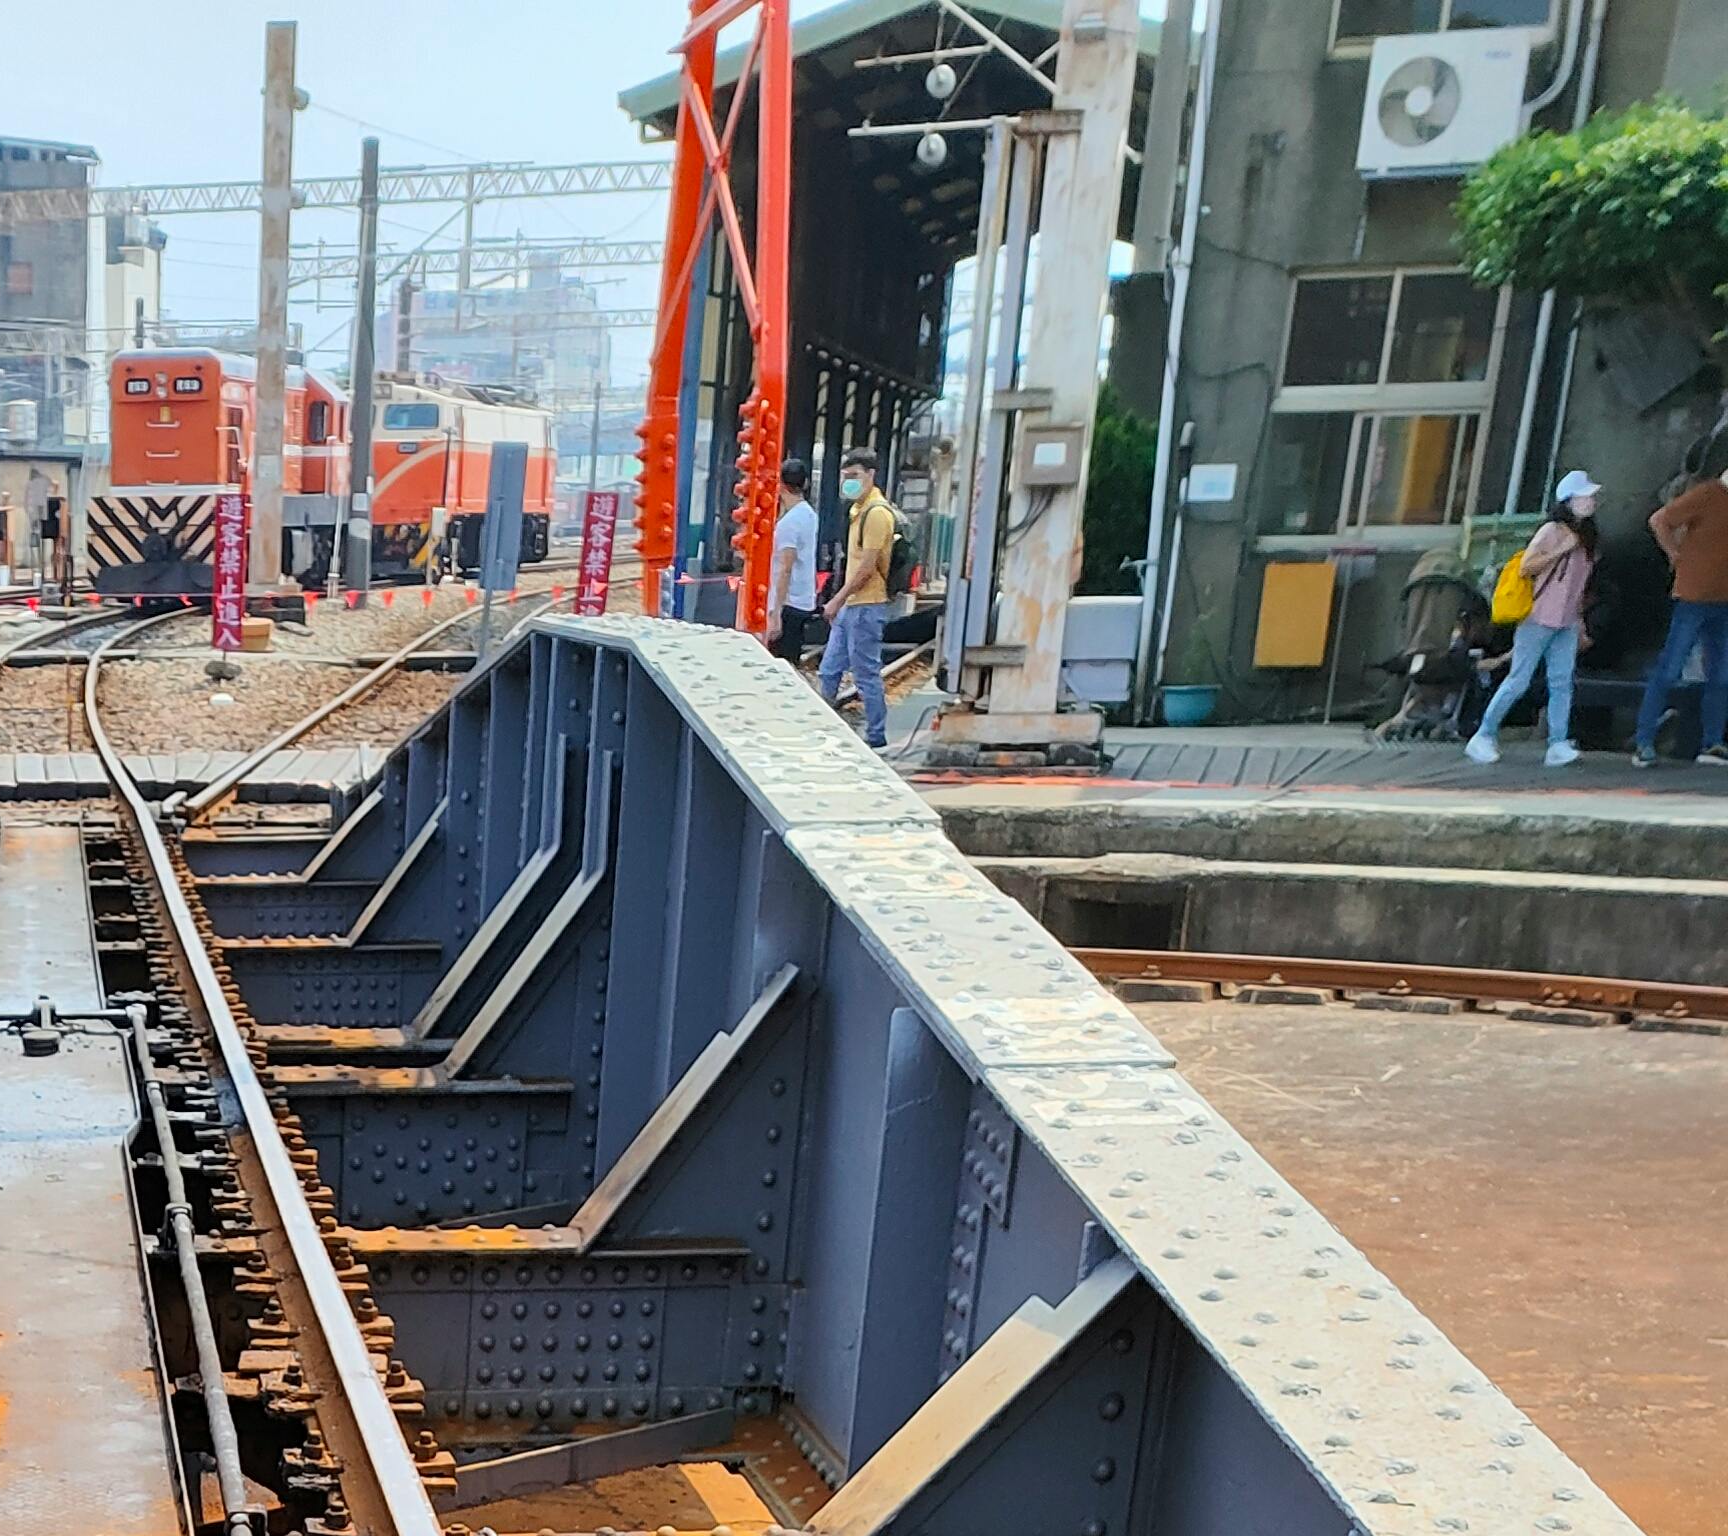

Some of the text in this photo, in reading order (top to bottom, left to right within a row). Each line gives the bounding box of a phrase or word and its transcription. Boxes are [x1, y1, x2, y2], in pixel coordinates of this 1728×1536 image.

[216, 496, 245, 647] 遊客禁止進入
